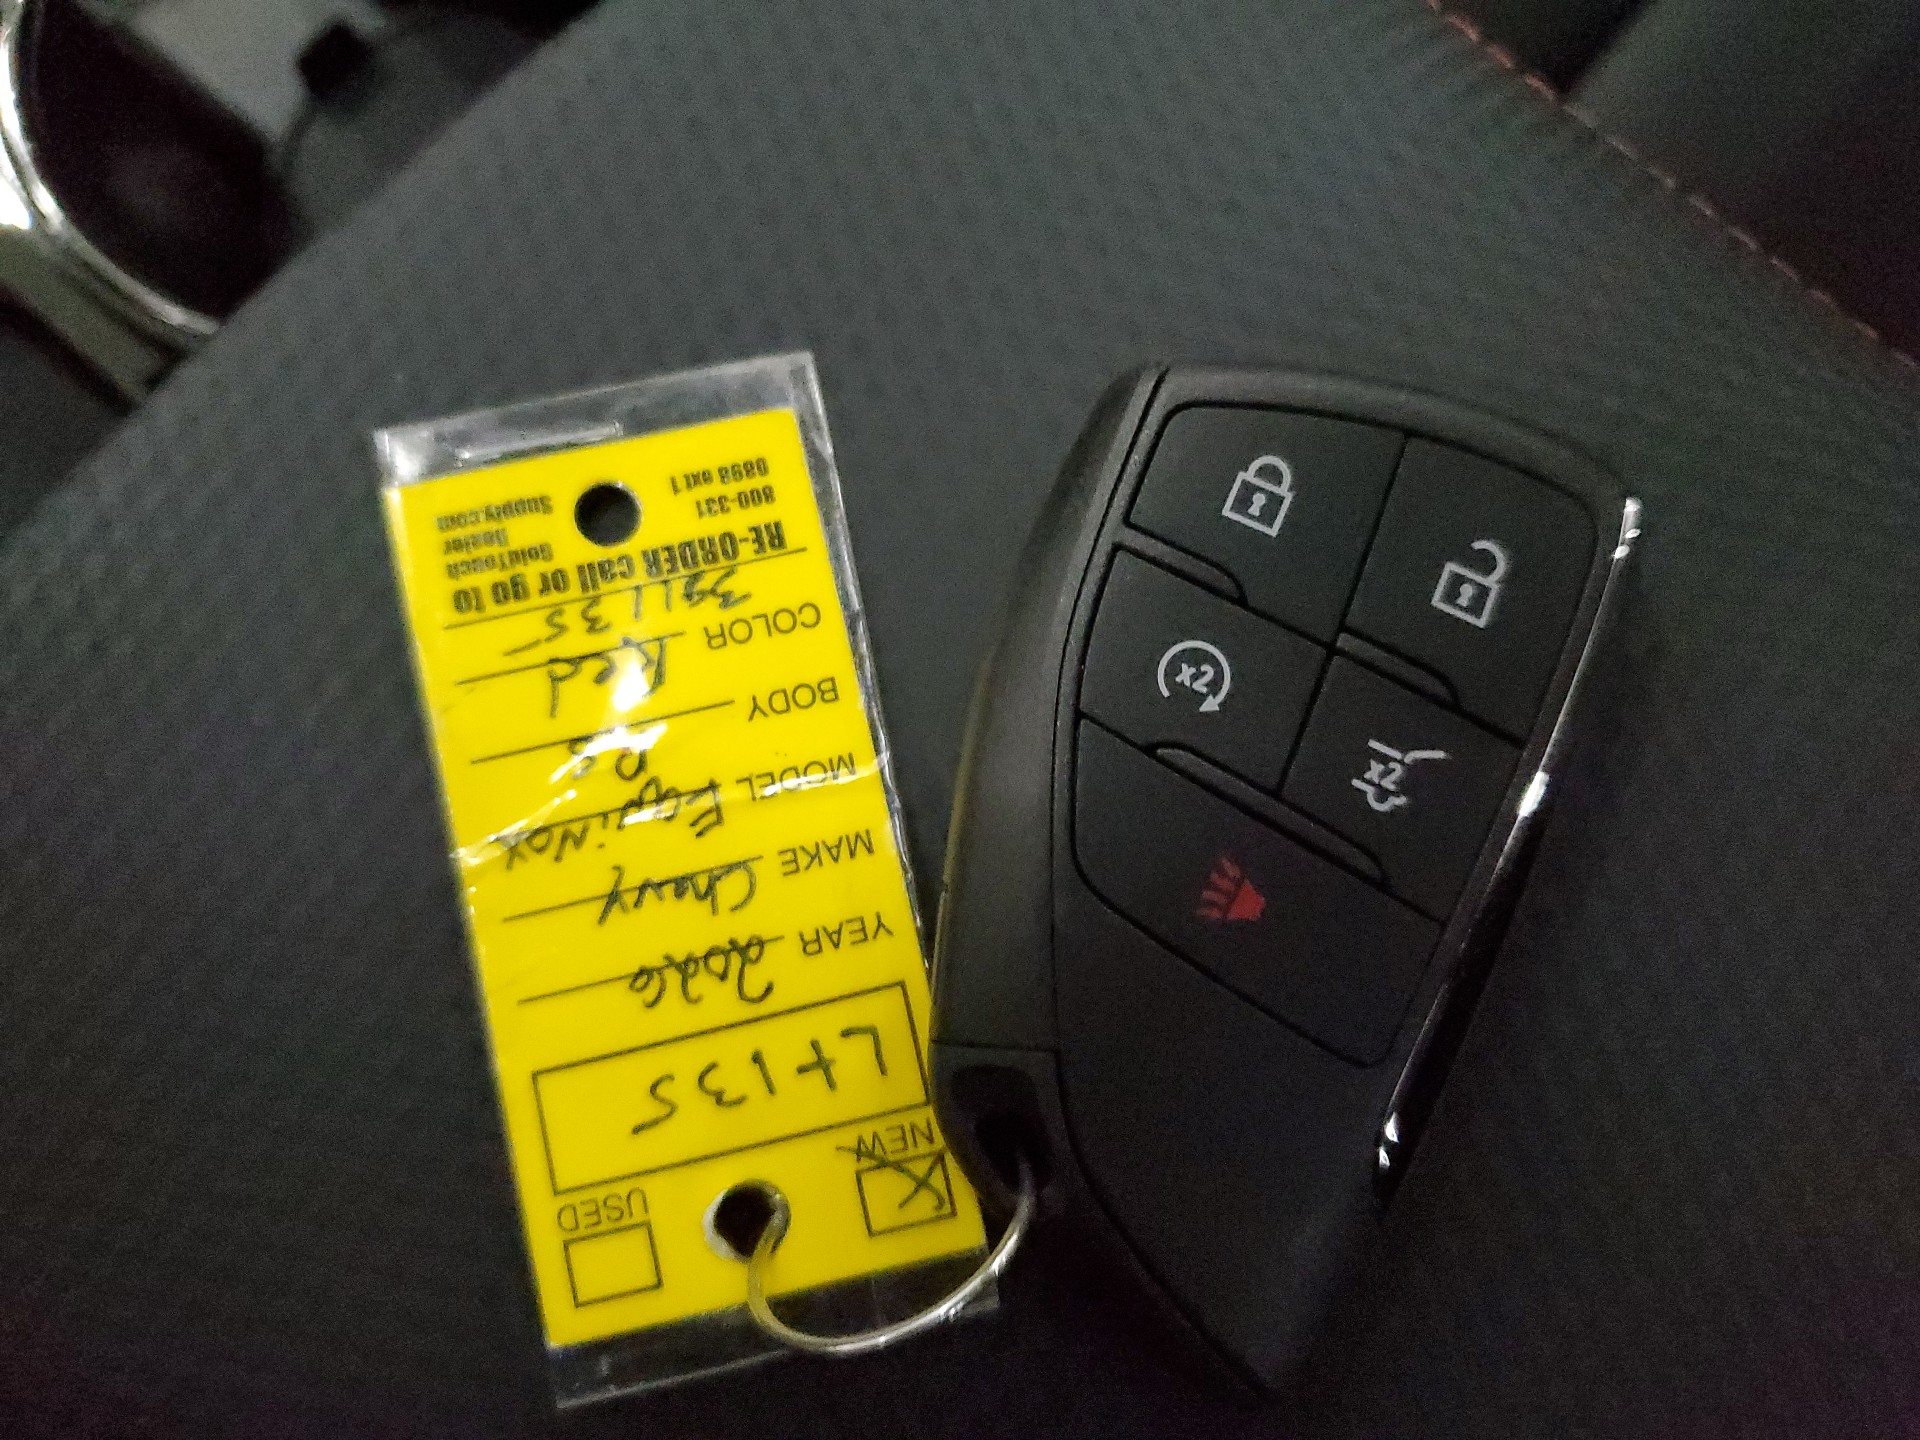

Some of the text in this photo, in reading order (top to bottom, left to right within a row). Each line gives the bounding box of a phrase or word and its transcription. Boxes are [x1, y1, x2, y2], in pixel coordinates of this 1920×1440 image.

[670, 475, 681, 497] 1
[683, 468, 714, 489] ext
[434, 495, 554, 534] Supply.com
[695, 485, 777, 520] 800-331
[443, 527, 508, 555] Dealer
[446, 543, 555, 580] GoldTouch
[452, 519, 788, 614] RE-ORDER call or go to
[703, 602, 823, 651] COLOR
[545, 635, 670, 719] Red
[747, 675, 839, 722] BODY
[736, 751, 857, 801] MODEL
[776, 828, 876, 877] MAKE
[597, 860, 758, 925] Chevy
[797, 911, 894, 958] YEAR
[627, 933, 775, 1010] 2026
[854, 1115, 937, 1163] NEW
[556, 1186, 651, 1233] USED
